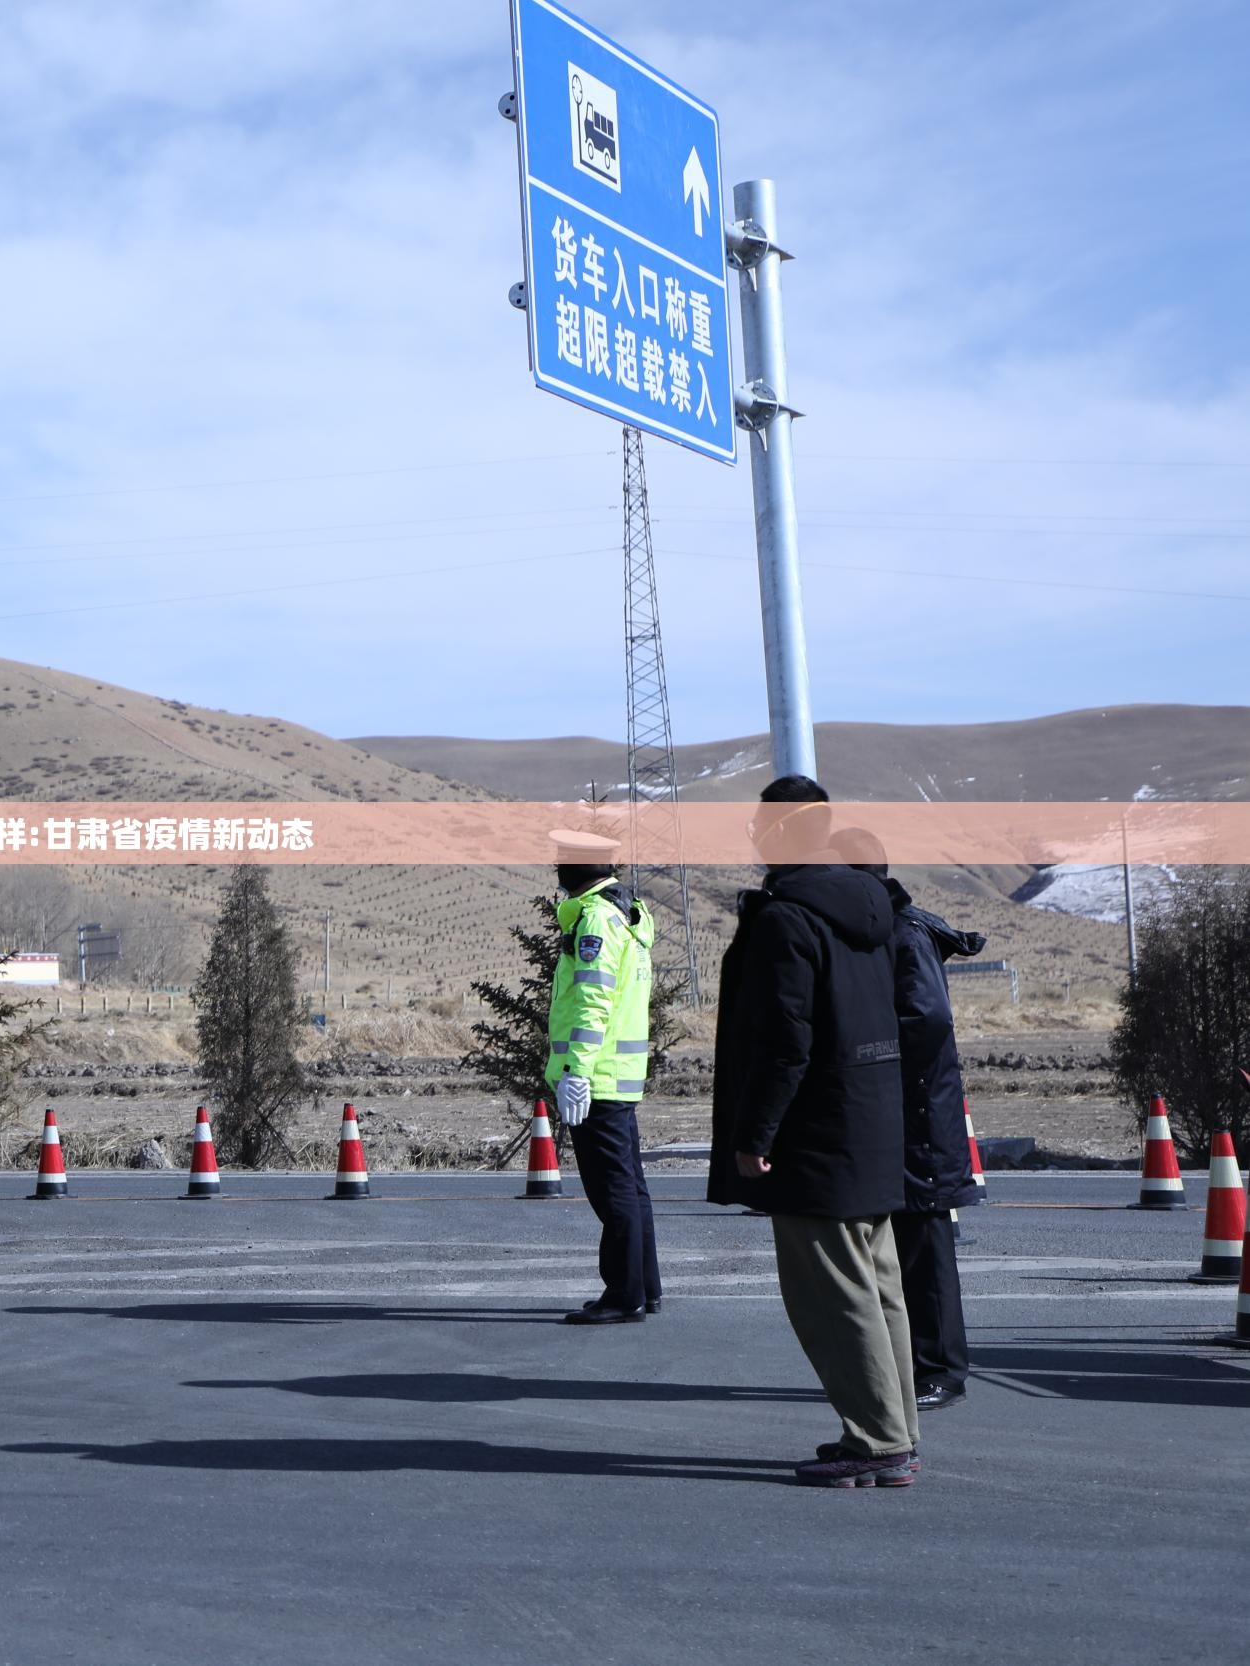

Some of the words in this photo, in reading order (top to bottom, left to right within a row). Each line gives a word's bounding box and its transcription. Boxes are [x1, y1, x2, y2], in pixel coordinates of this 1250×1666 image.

[551, 215, 714, 358] 货车入口称重
[555, 294, 718, 428] 超限超载禁入
